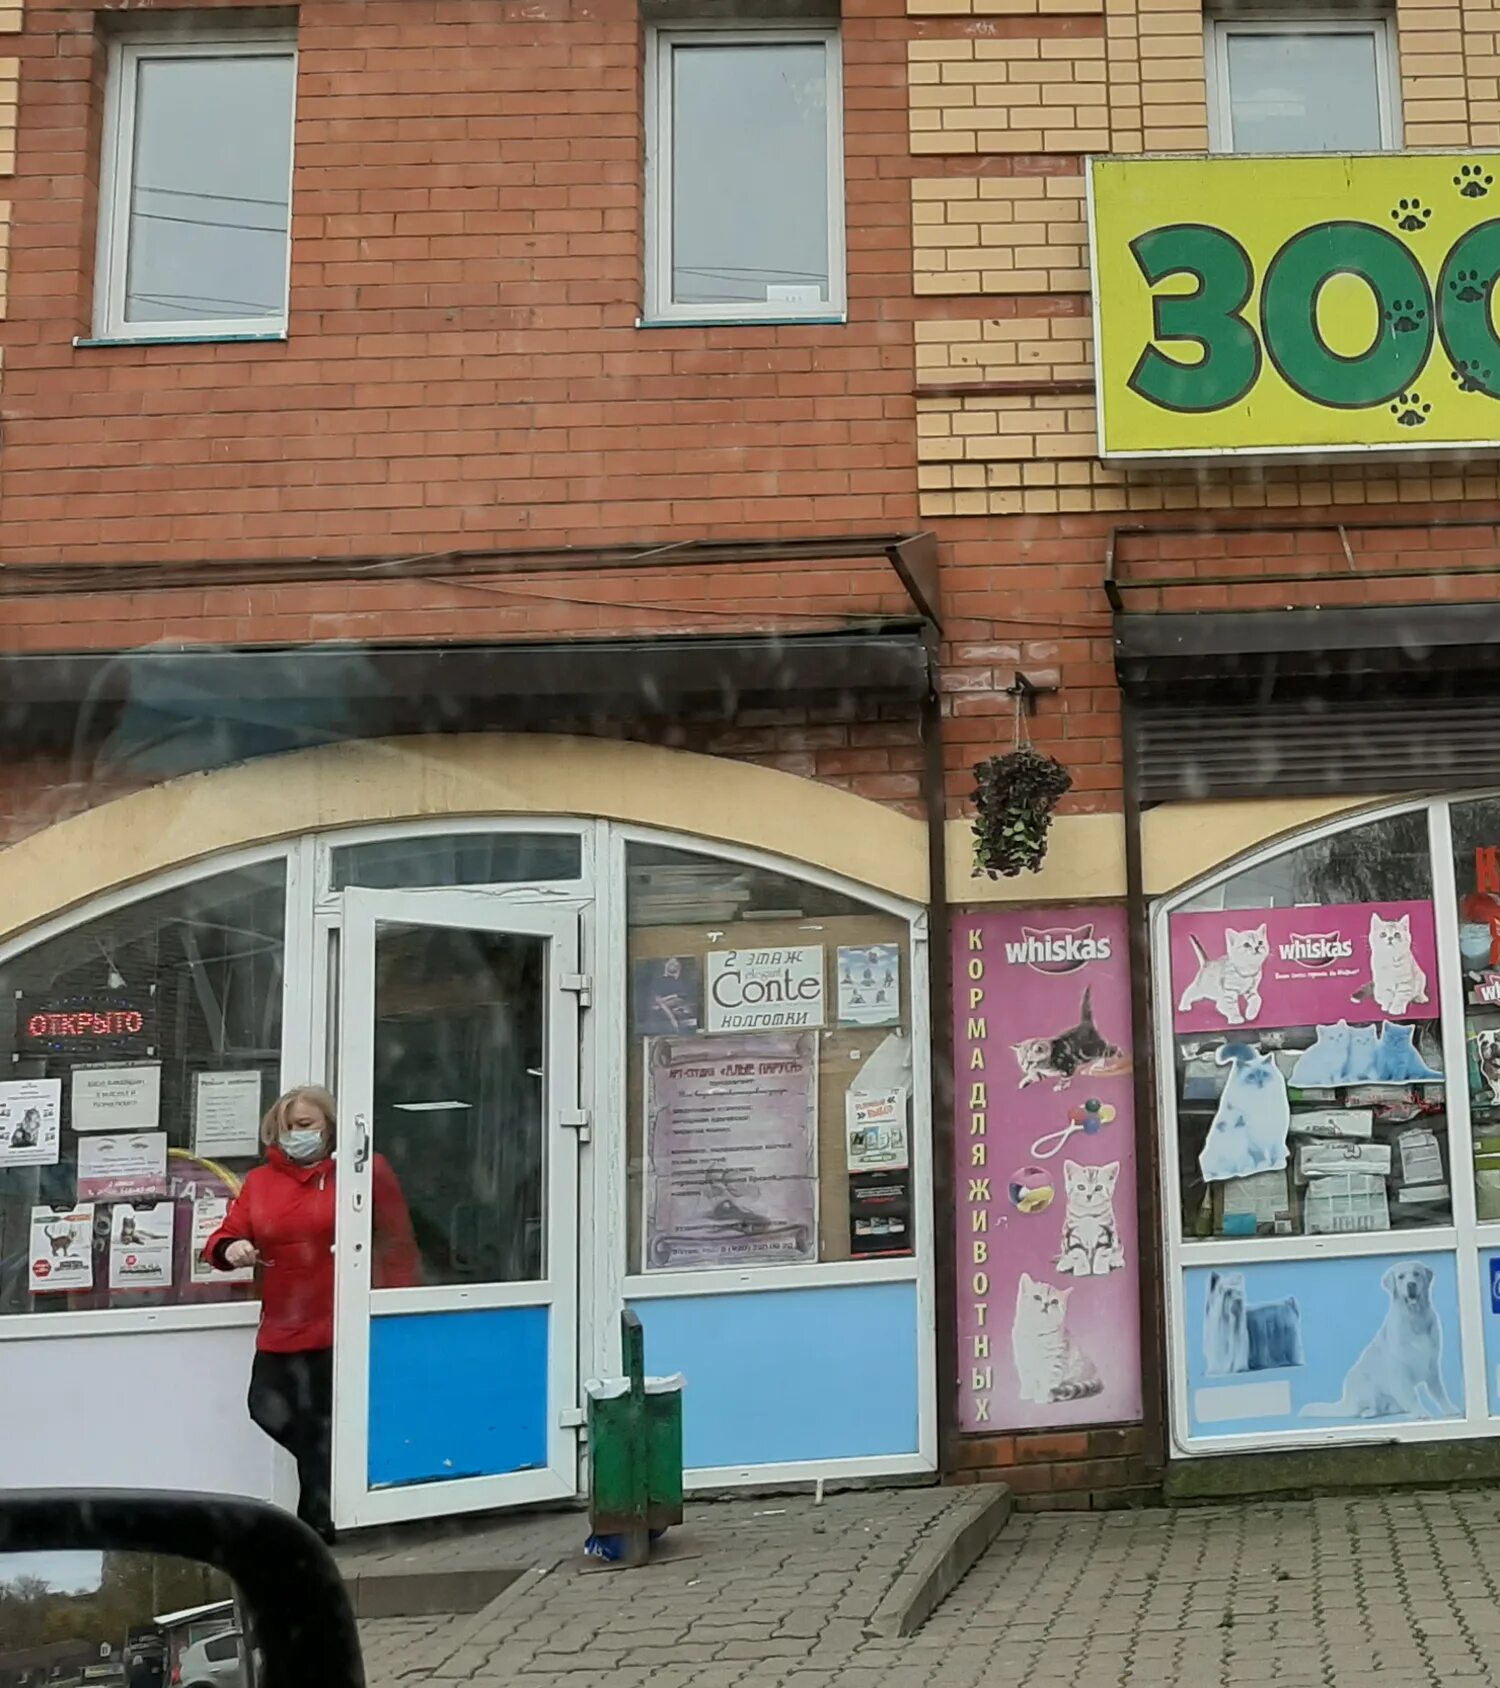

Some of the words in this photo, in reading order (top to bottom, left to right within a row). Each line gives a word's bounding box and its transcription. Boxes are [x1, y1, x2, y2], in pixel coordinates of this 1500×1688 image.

[724, 951, 738, 968] 2
[1005, 935, 1112, 965] whiskas
[1278, 938, 1353, 961] whiskas
[712, 967, 821, 1009] Conte
[967, 928, 987, 1071] КОРМА
[29, 1010, 144, 1037] ОТКРЫТО
[969, 1082, 987, 1166] ДЛЯ
[968, 1178, 992, 1422] ЖИВОТНЫХ
